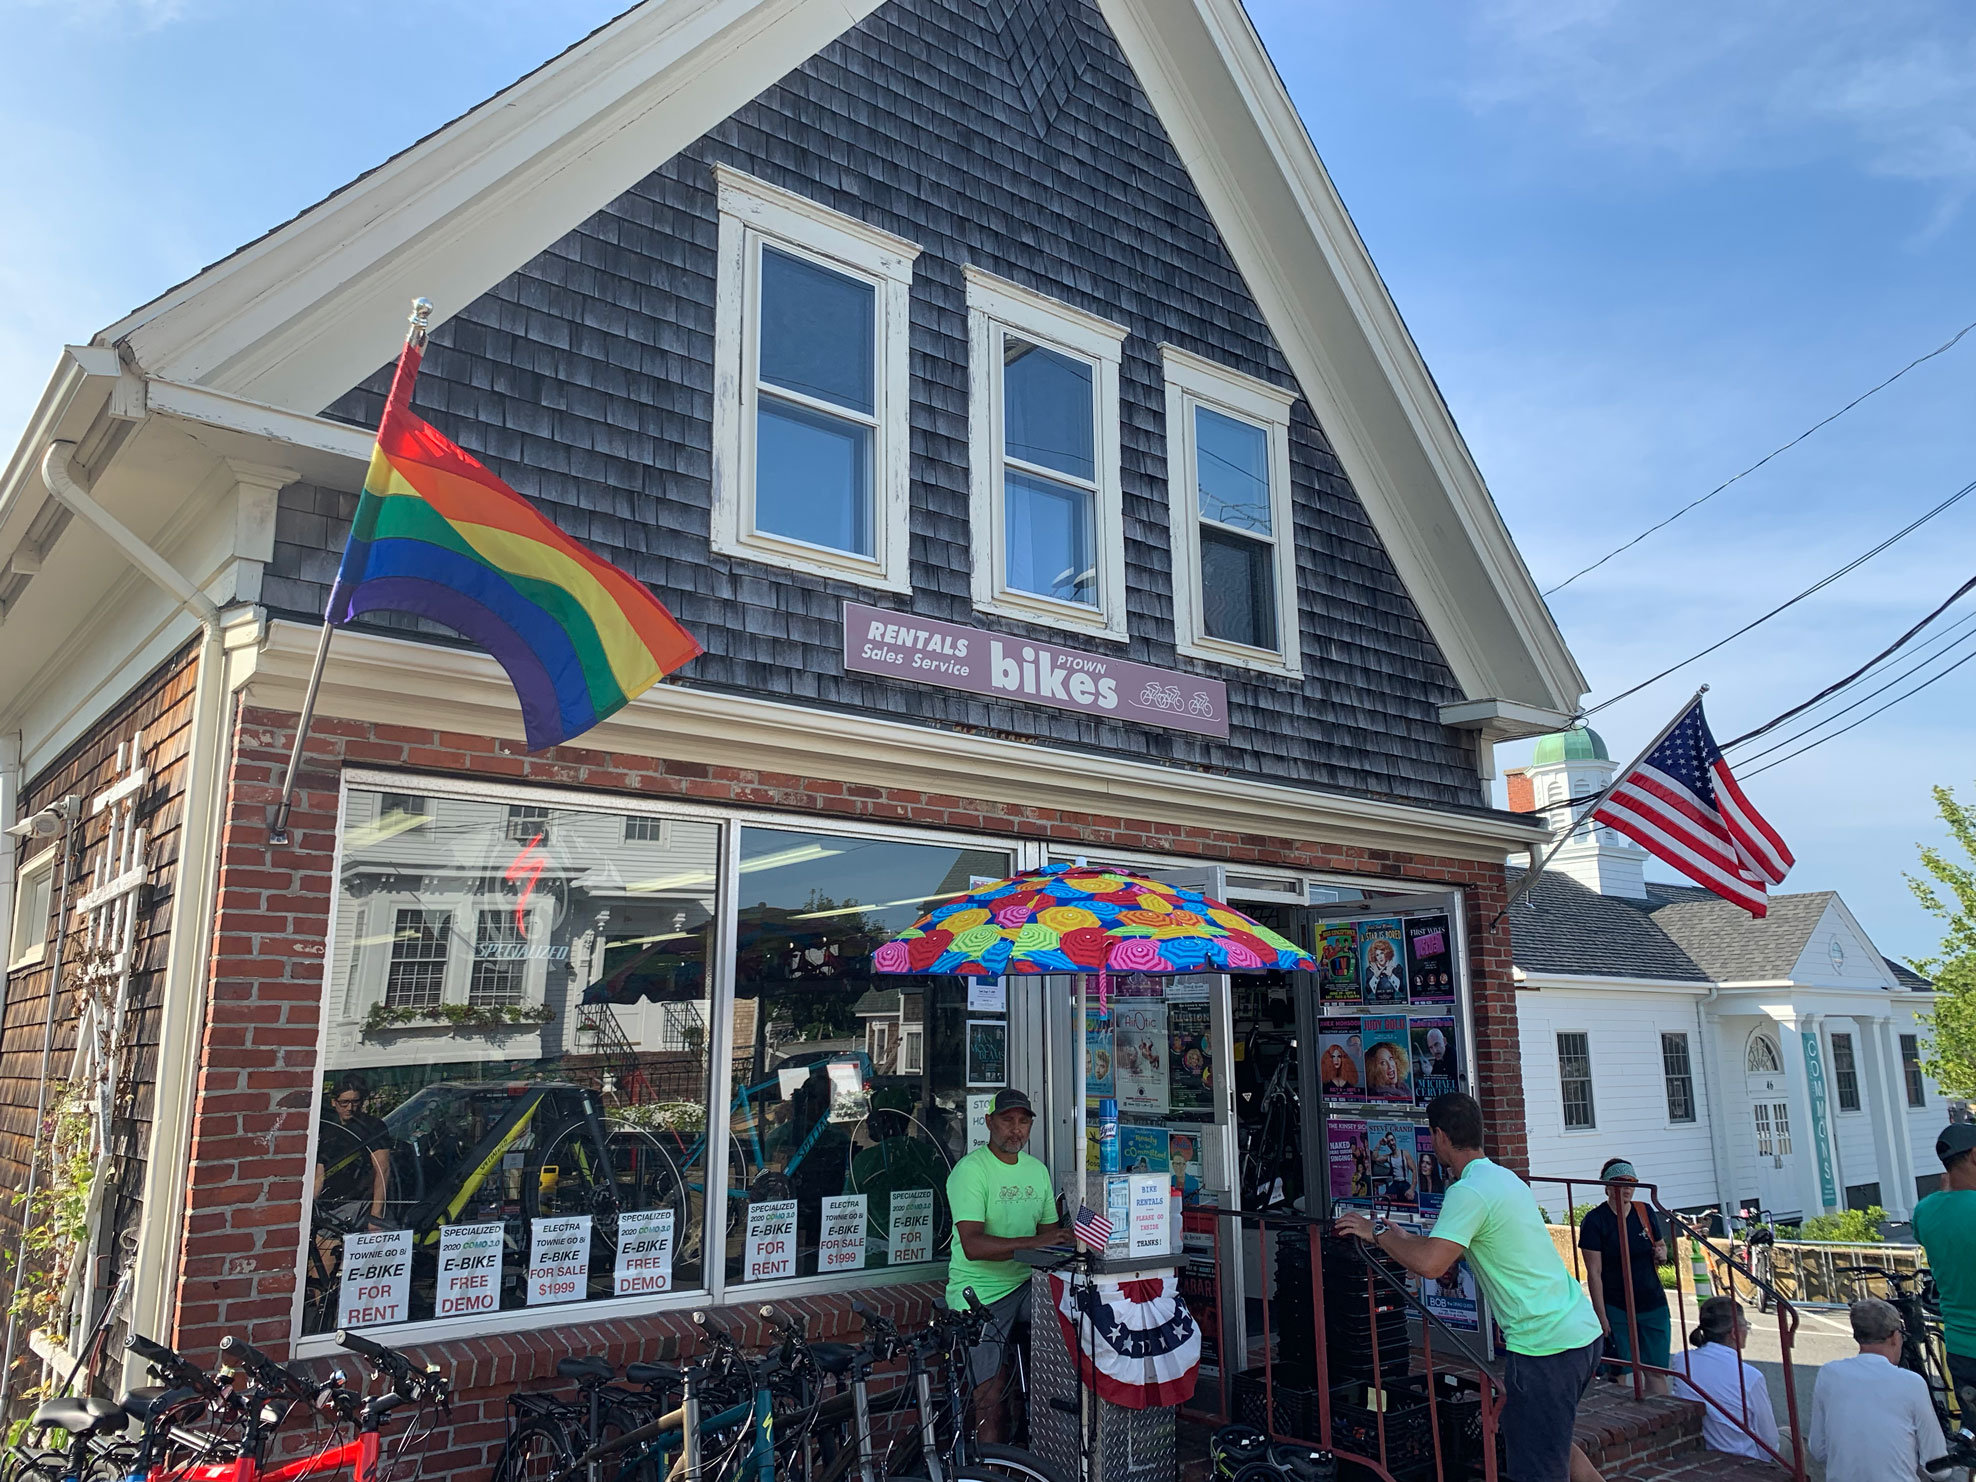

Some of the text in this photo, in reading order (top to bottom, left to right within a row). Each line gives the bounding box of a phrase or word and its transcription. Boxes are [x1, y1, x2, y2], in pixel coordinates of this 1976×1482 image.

[867, 621, 969, 657] RENTALS
[861, 643, 970, 677] Sales Service
[1057, 655, 1106, 675] PTOWN
[990, 640, 1119, 709] bikes
[475, 944, 569, 960] SPECIALIZED
[1364, 1020, 1382, 1030] JUDY
[1766, 1080, 1774, 1090] 46
[1808, 1040, 1830, 1178] COMMONS
[892, 1191, 931, 1200] SPECIALIZED
[1136, 1198, 1163, 1206] RENTALS
[750, 1202, 795, 1213] SPECIALIZED
[621, 1212, 671, 1223] SPECIALIZED
[894, 1215, 929, 1228] E-BIKE
[443, 1226, 501, 1237] SPECIALIZED
[542, 1223, 580, 1233] ELECTRA
[750, 1223, 793, 1237] E-BIKE
[828, 1225, 859, 1236] E-BIKE
[357, 1234, 401, 1245] ELECTRA
[536, 1238, 566, 1247] TOWNIE
[821, 1237, 864, 1249] FOR SALE
[900, 1232, 922, 1243] FOR
[1136, 1238, 1162, 1248] THANKS!
[443, 1240, 500, 1252] 2020 COMO 3.0
[622, 1239, 668, 1254] E-BIKE
[757, 1241, 785, 1255] FOR
[350, 1251, 383, 1260] TOWNIE
[385, 1249, 398, 1257] GO
[540, 1250, 580, 1263] E-BIKE
[827, 1252, 856, 1265] $1999
[894, 1248, 926, 1262] RENT
[444, 1255, 497, 1271] E-BIKE
[626, 1257, 661, 1271] FREE
[752, 1260, 789, 1275] RENT
[348, 1263, 405, 1281] E-BIKE
[530, 1264, 587, 1279] FOR SALE
[450, 1275, 489, 1290] FREE
[539, 1282, 575, 1296] $1999
[620, 1275, 666, 1292] DEMO
[358, 1284, 392, 1300] FOR
[442, 1294, 494, 1314] DEMO
[1430, 1297, 1446, 1308] BOB
[348, 1304, 399, 1324] RENT
